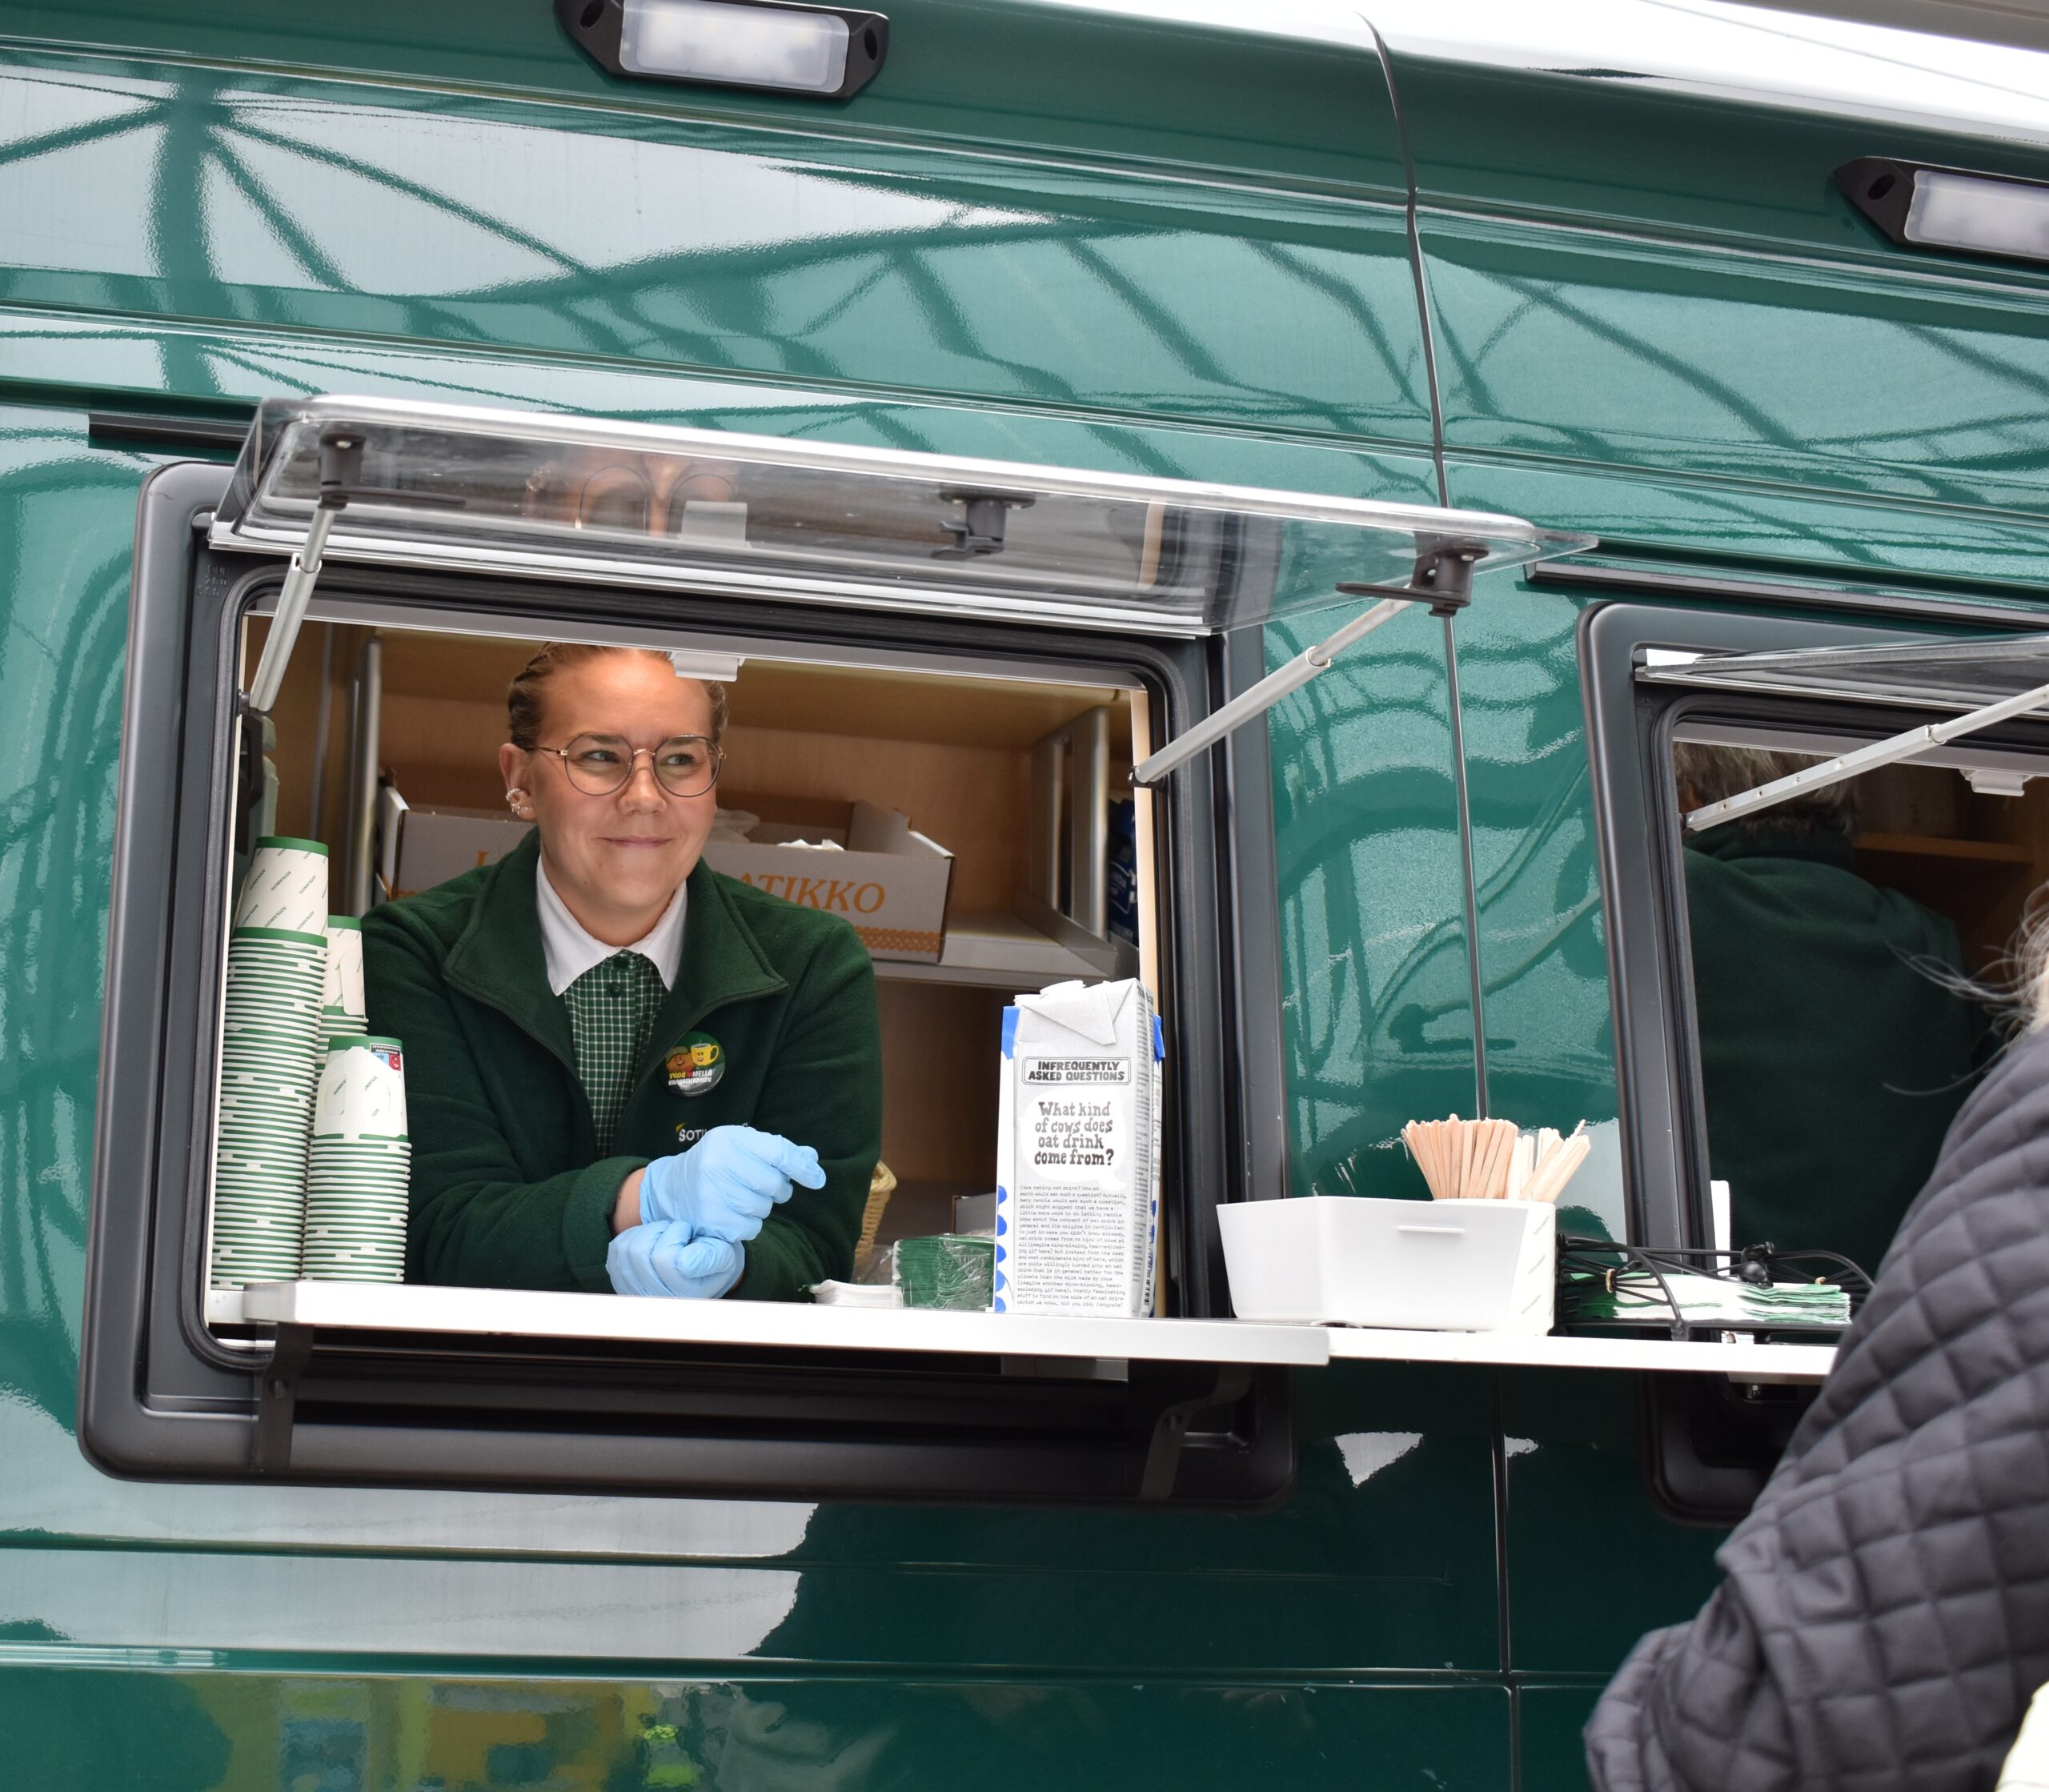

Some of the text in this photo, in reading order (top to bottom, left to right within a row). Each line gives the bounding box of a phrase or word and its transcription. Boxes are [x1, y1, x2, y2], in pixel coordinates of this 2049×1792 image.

[1038, 1060, 1121, 1071] INFREQUENTLY
[1029, 1071, 1125, 1081] ASKED QUESTIONS
[1038, 1101, 1111, 1116] What kind
[1035, 1117, 1113, 1134] of cows does
[1038, 1134, 1104, 1149] oat drink
[1034, 1149, 1114, 1166] come from?
